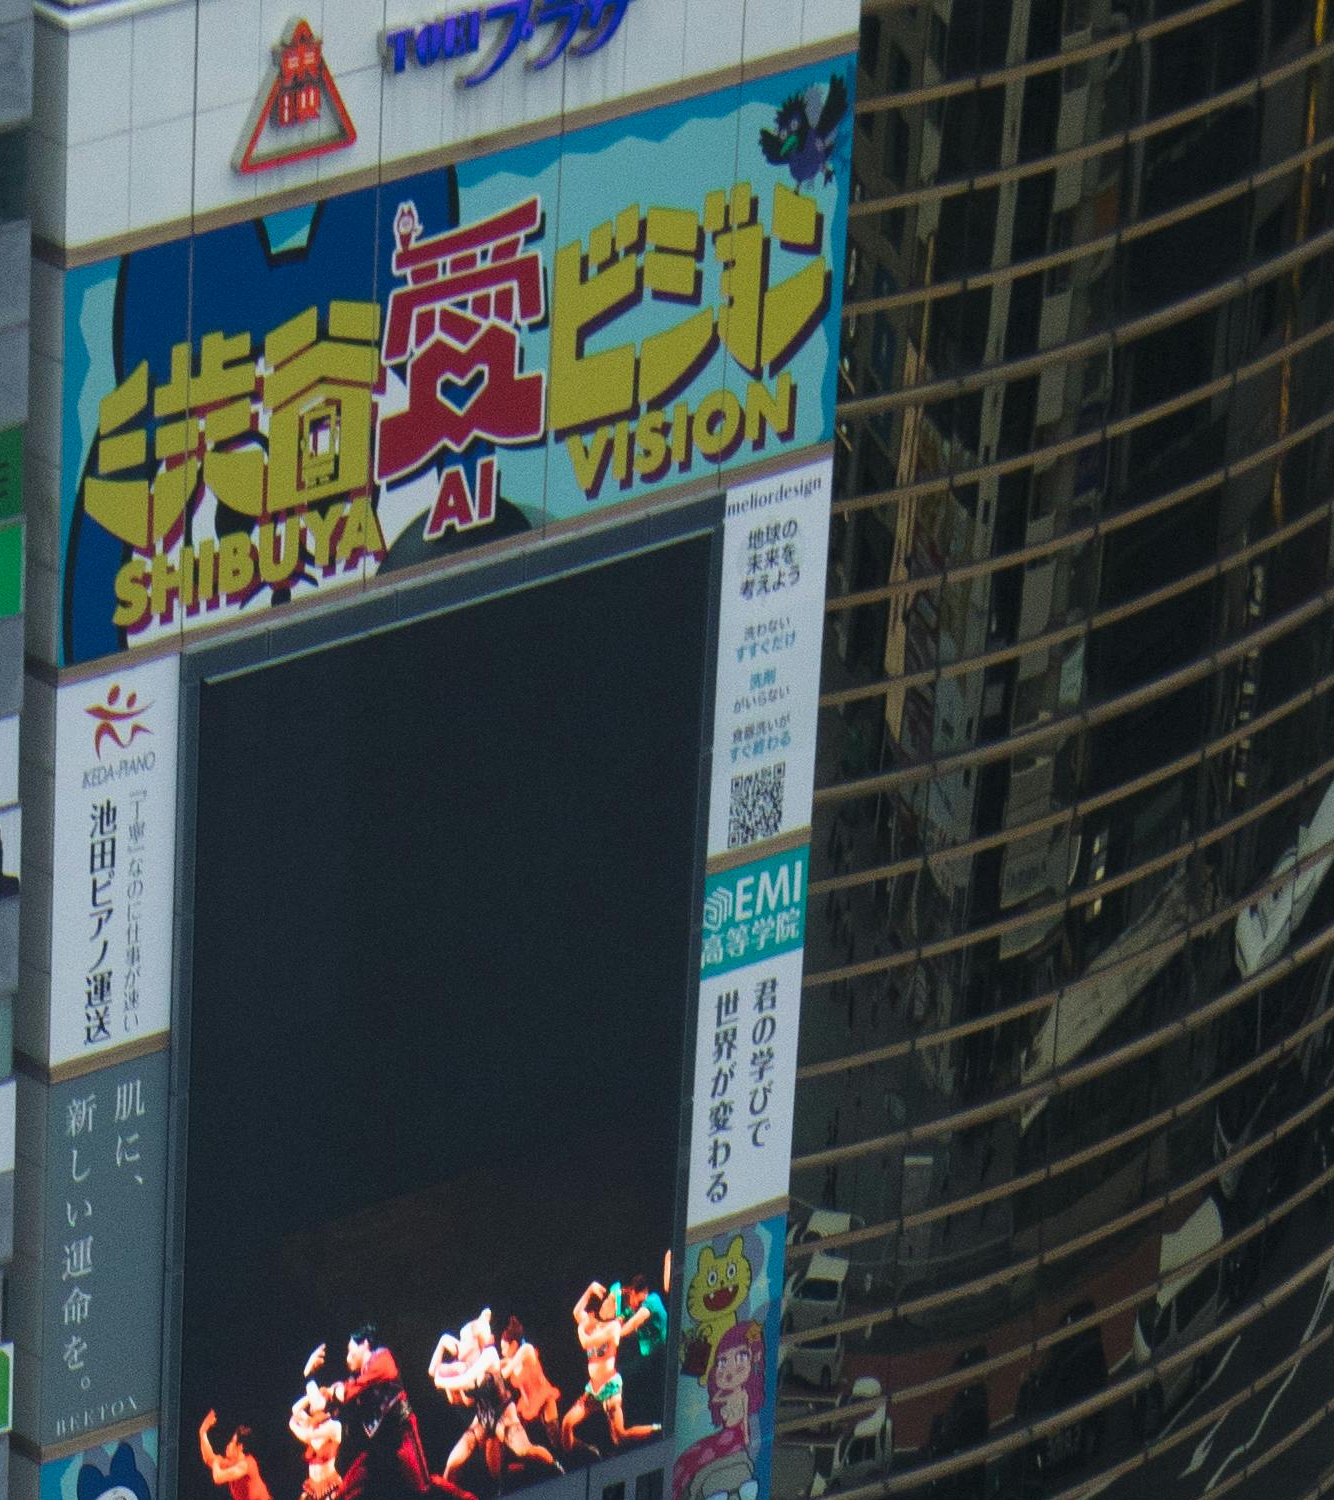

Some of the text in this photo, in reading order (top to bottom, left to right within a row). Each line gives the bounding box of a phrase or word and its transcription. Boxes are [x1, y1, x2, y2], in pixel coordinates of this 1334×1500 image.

[424, 458, 497, 539] AI
[565, 372, 795, 499] VISION
[112, 501, 386, 627] SHIBUYA
[746, 542, 794, 573] 未来を
[747, 519, 799, 550] 地球の
[83, 798, 118, 1047] 池田ピアノ運送
[701, 907, 800, 968] 高等学院
[734, 860, 804, 921] EMI
[705, 988, 740, 1204] 世界が変わる
[748, 976, 779, 1149] 君の学びで
[62, 1092, 98, 1391] 新しい運命を。
